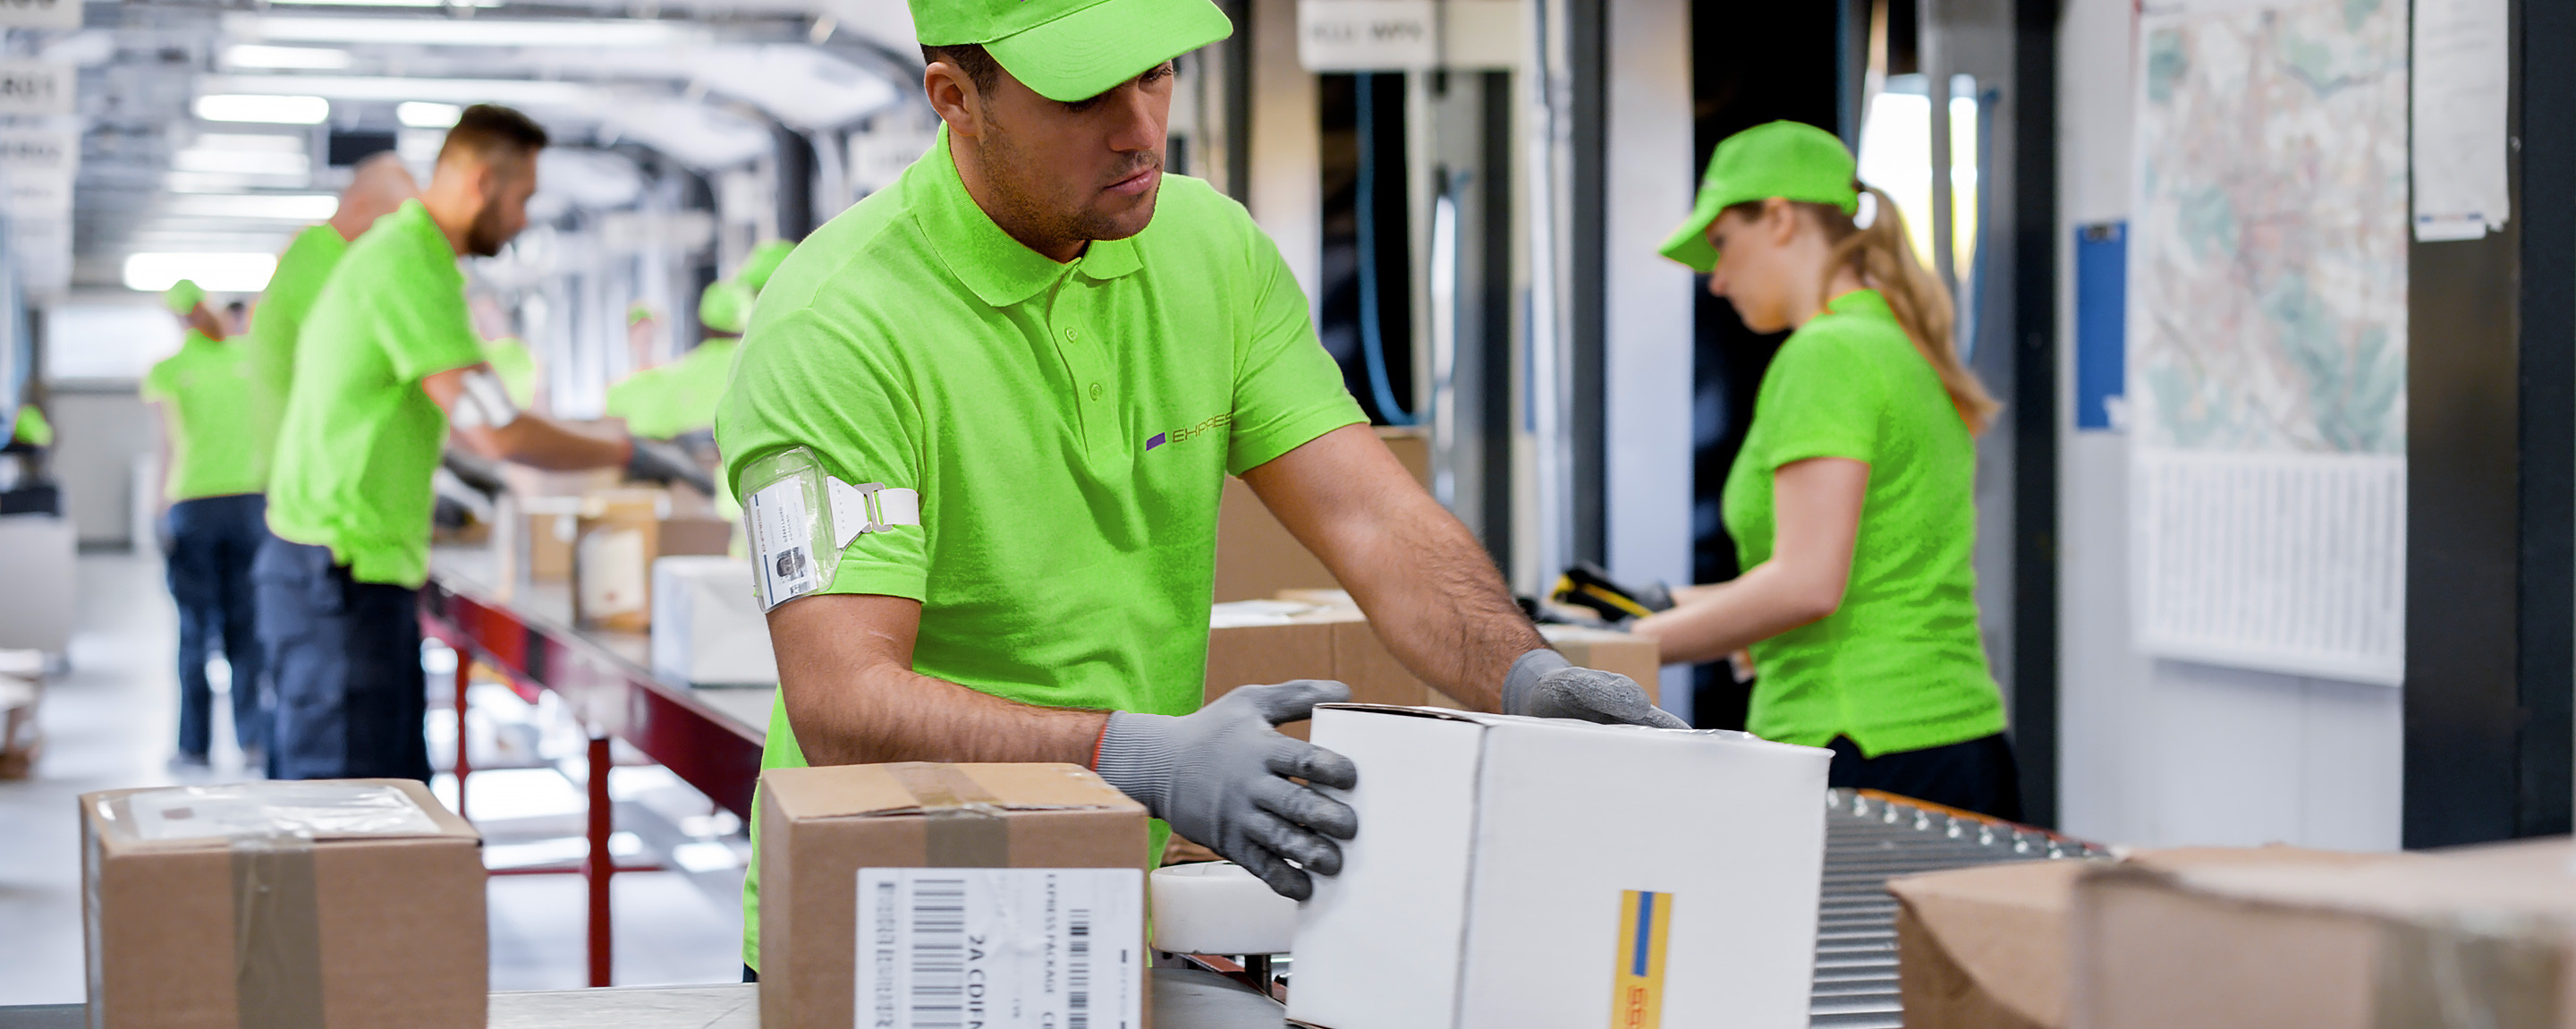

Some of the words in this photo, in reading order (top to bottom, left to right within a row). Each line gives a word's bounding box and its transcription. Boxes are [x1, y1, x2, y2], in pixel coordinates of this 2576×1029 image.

[1045, 873, 1057, 931] EXPRESS
[969, 935, 986, 962] 2A
[1044, 934, 1056, 993] PACKAGE
